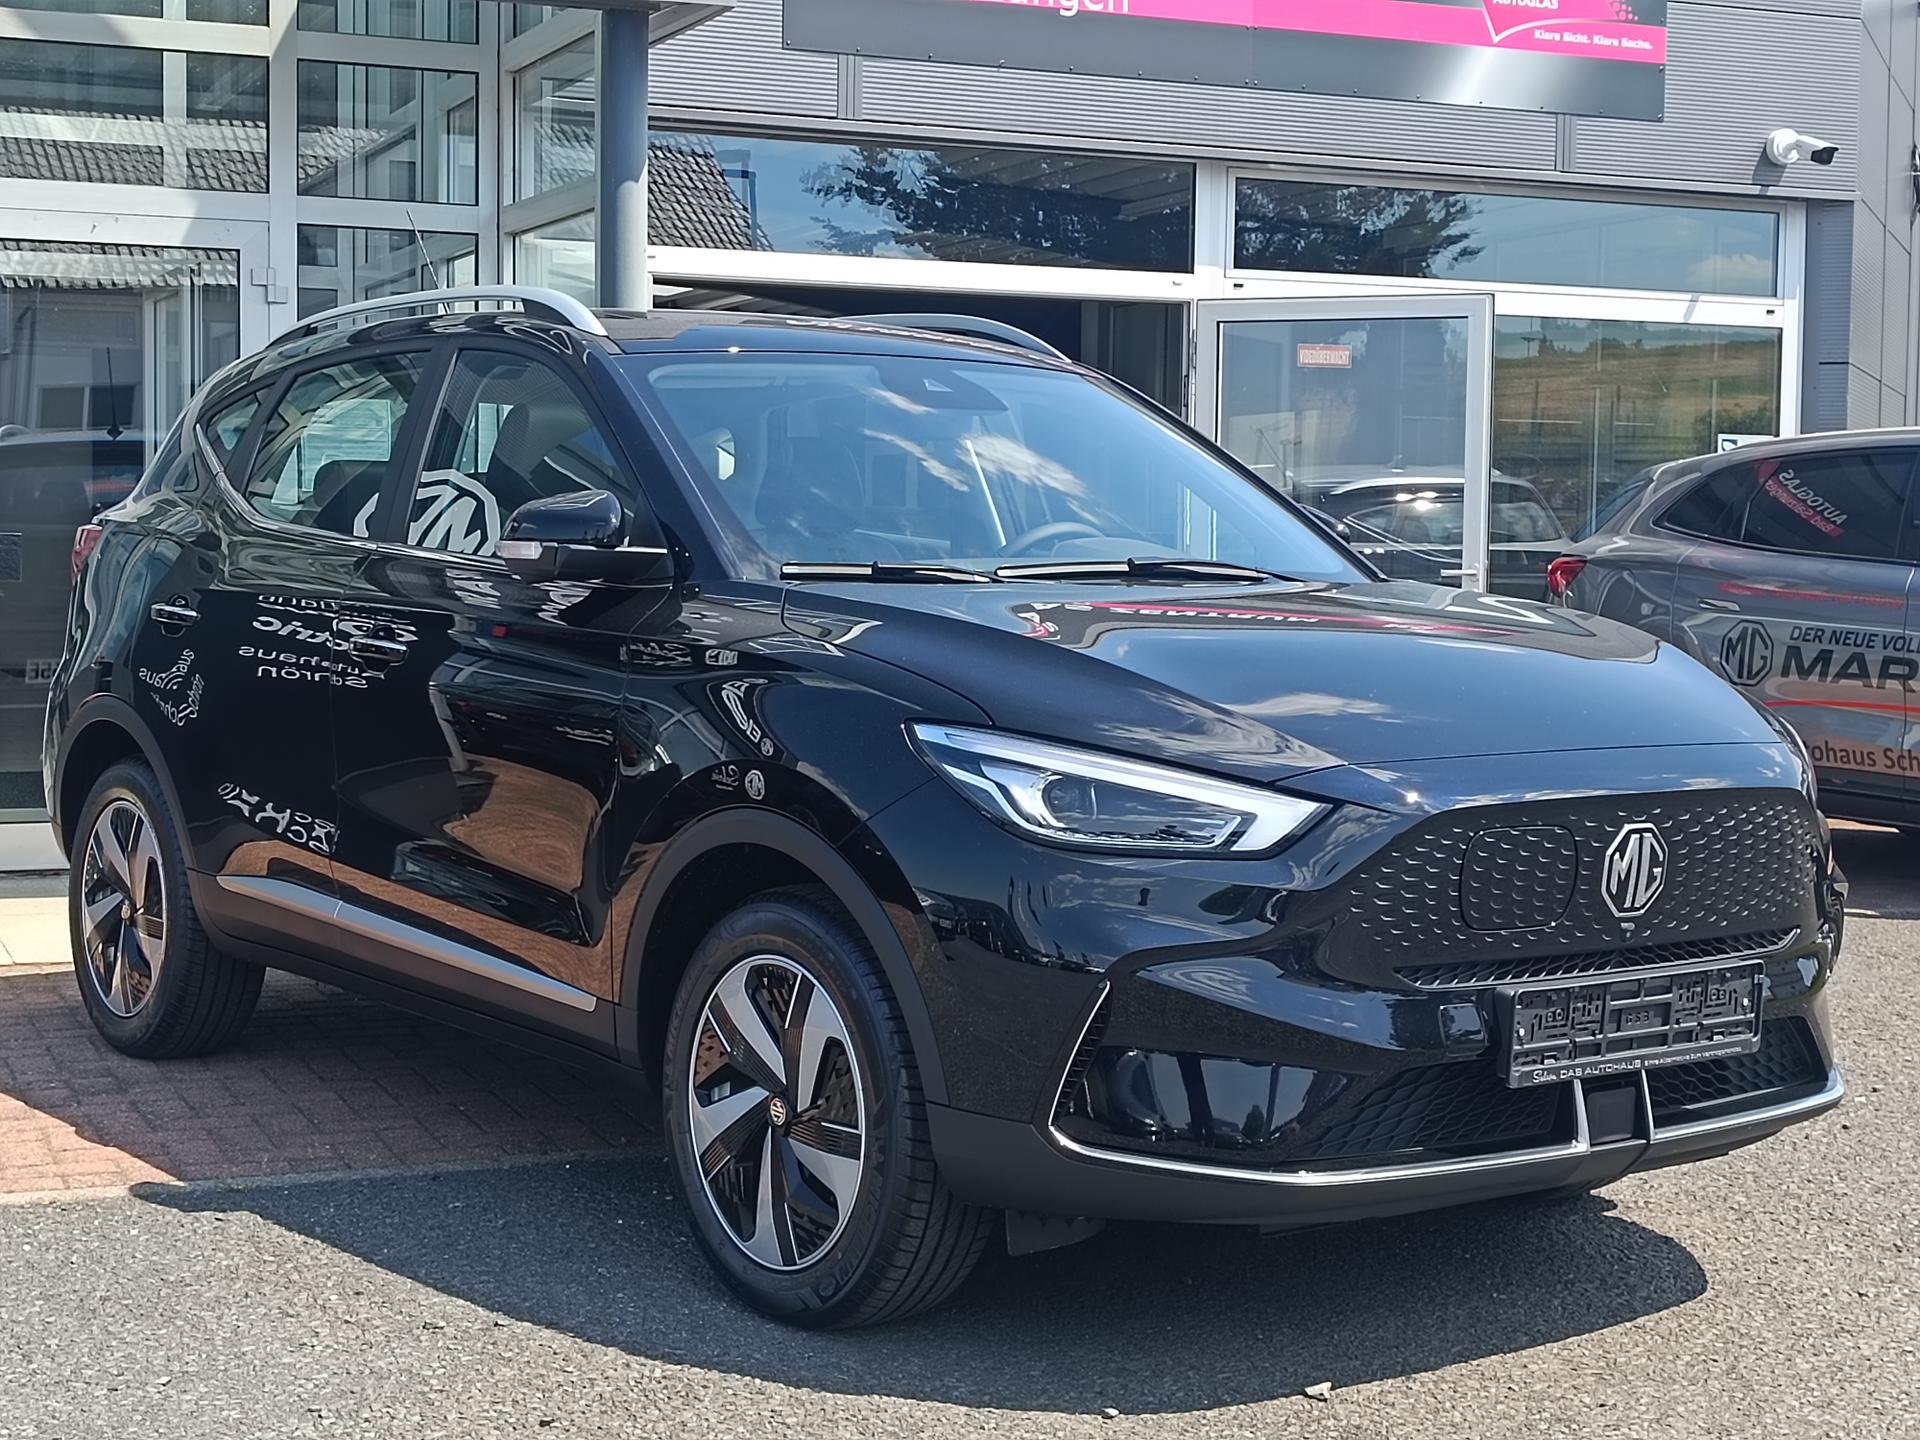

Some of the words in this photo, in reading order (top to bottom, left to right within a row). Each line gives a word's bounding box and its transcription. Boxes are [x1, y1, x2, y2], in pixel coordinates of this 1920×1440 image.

[1534, 29, 1561, 41] Klare
[1563, 31, 1591, 44] Sicht.
[1593, 34, 1619, 47] Klare
[1621, 37, 1653, 50] Sache.
[1720, 620, 1774, 686] MG
[1789, 626, 1826, 644] DER
[1828, 630, 1878, 649] NEUE
[1780, 645, 1919, 693] MAR
[1603, 825, 1668, 915] MG
[1584, 1060, 1641, 1077] AUTOHAUS
